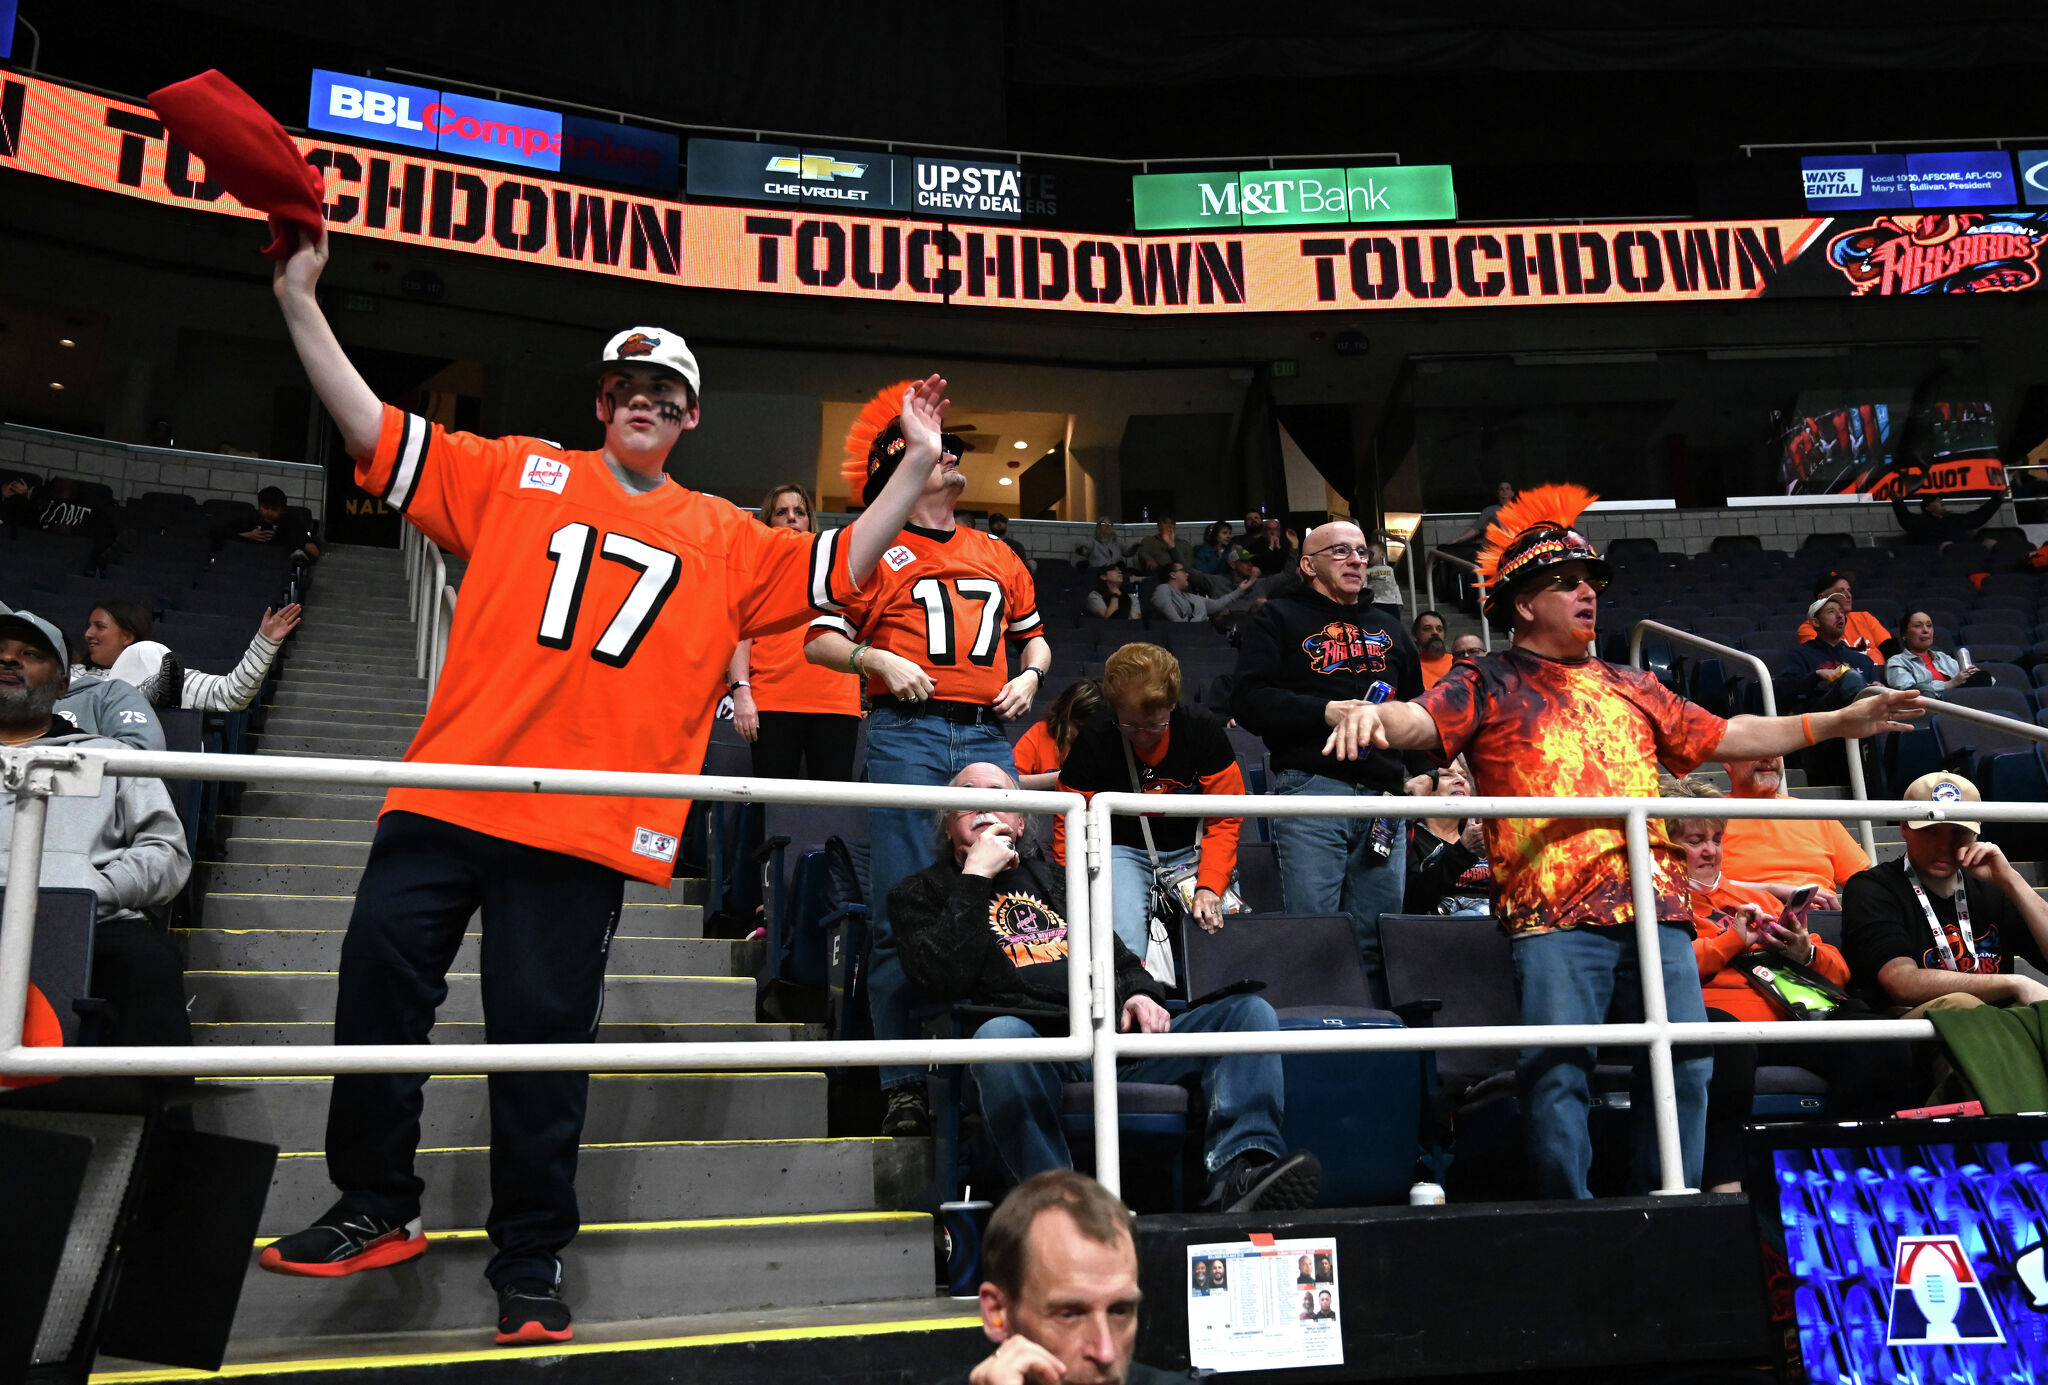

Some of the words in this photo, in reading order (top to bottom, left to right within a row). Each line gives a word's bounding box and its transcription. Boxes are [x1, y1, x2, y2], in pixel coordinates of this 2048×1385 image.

[329, 84, 423, 131] BBL
[105, 106, 683, 276] TOCHDOWN
[764, 183, 870, 201] CHEVROLET
[1197, 180, 1295, 216] M&T
[1299, 178, 1392, 213] Bank
[1870, 174, 1895, 183] Local
[1922, 172, 1963, 182] AFSCME,
[1965, 171, 2002, 180] AFL-CIO
[1871, 183, 1895, 193] Mary
[1896, 183, 1907, 191] E.
[1909, 181, 1947, 192] Sullivan,
[1948, 181, 1992, 190] President
[918, 191, 974, 209] CHEVY
[744, 215, 1246, 307] TOUCHDOWN
[1300, 226, 1783, 302] TOUCHDOWN
[537, 521, 682, 669] 17
[910, 577, 1005, 667] 17
[119, 710, 148, 724] 75
